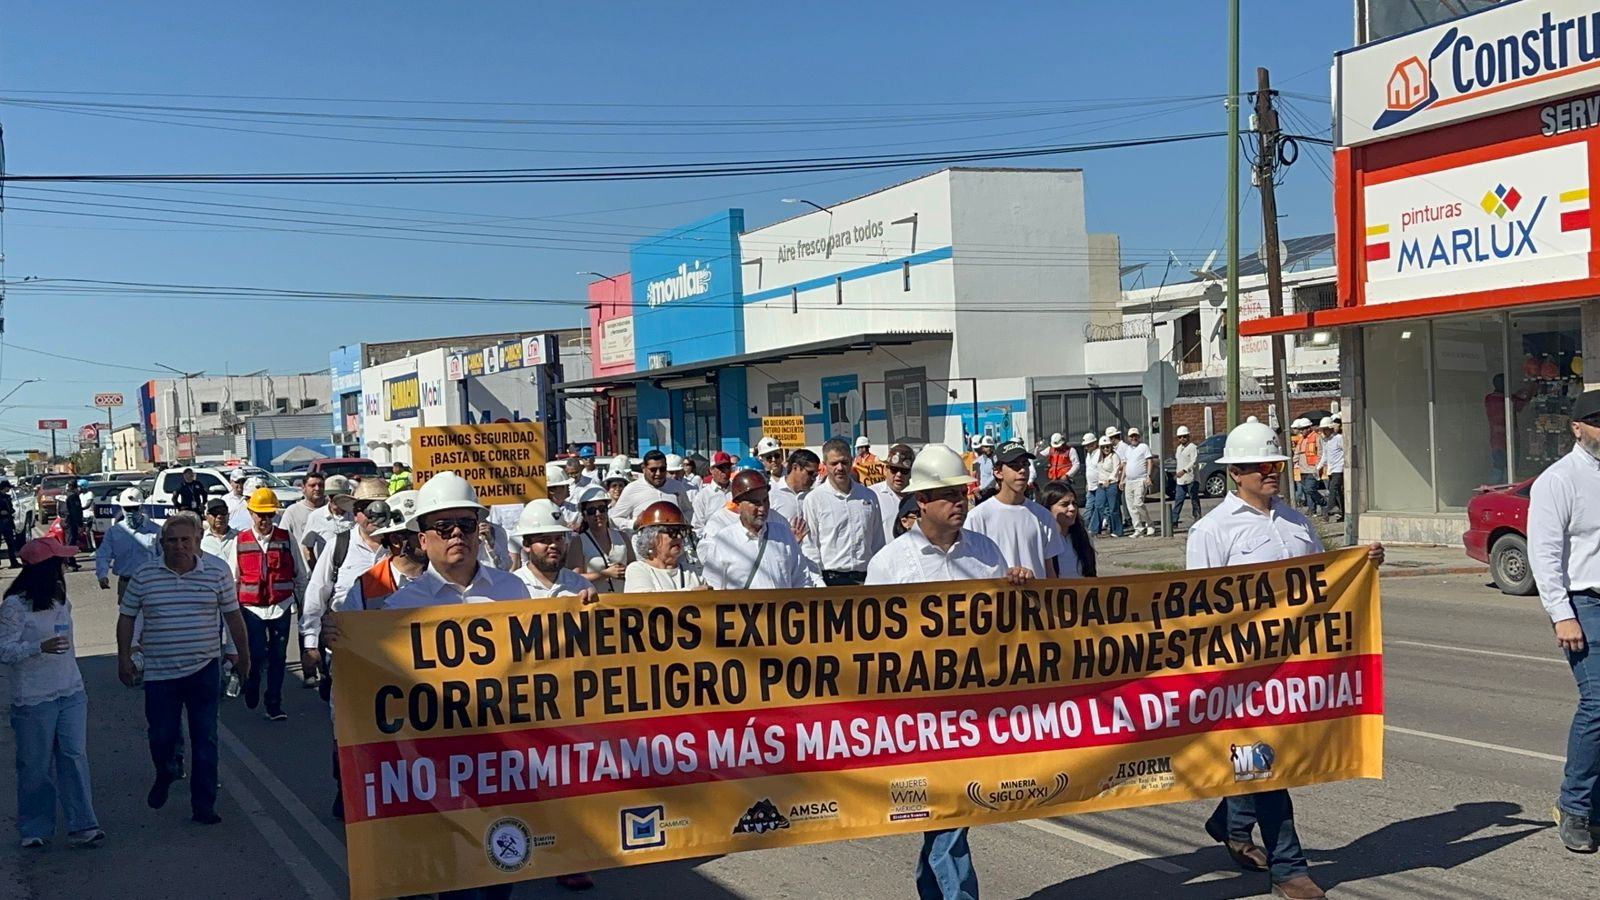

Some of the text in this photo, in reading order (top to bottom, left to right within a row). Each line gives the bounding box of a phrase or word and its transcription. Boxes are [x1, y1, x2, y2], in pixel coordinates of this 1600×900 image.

[1541, 96, 1600, 136] SERV
[1401, 202, 1462, 232] pinturas
[778, 219, 884, 264] Aire fresco para todos
[1397, 196, 1548, 273] MARLUX
[96, 395, 122, 405] OXXO
[422, 378, 442, 407] Mobil
[420, 431, 538, 448] EXIGIMOS SEGURIDAD.
[430, 448, 530, 468] ¡BASTA DE CORRER
[464, 466, 486, 481] POR
[489, 465, 545, 479] TRABAJAR
[474, 483, 526, 498] TAMENTE!
[411, 564, 1328, 670] LOS MINEROS EXIGIMOS SEGURIDAD. ¡BASTA DE
[375, 611, 1353, 734] CORRER PELIGRO POR TRABAJAR HONESTAMENTE!
[364, 670, 1363, 817] ¡NO PERMITAMOS MÁS MASACRES COMO LA DE CONCORDIA!
[1116, 756, 1172, 779] ASORM
[891, 779, 928, 789] MUJERES
[1001, 779, 1037, 789] MINERIA
[989, 787, 1049, 804] SIGLO XXI
[790, 801, 838, 817] AMSAC
